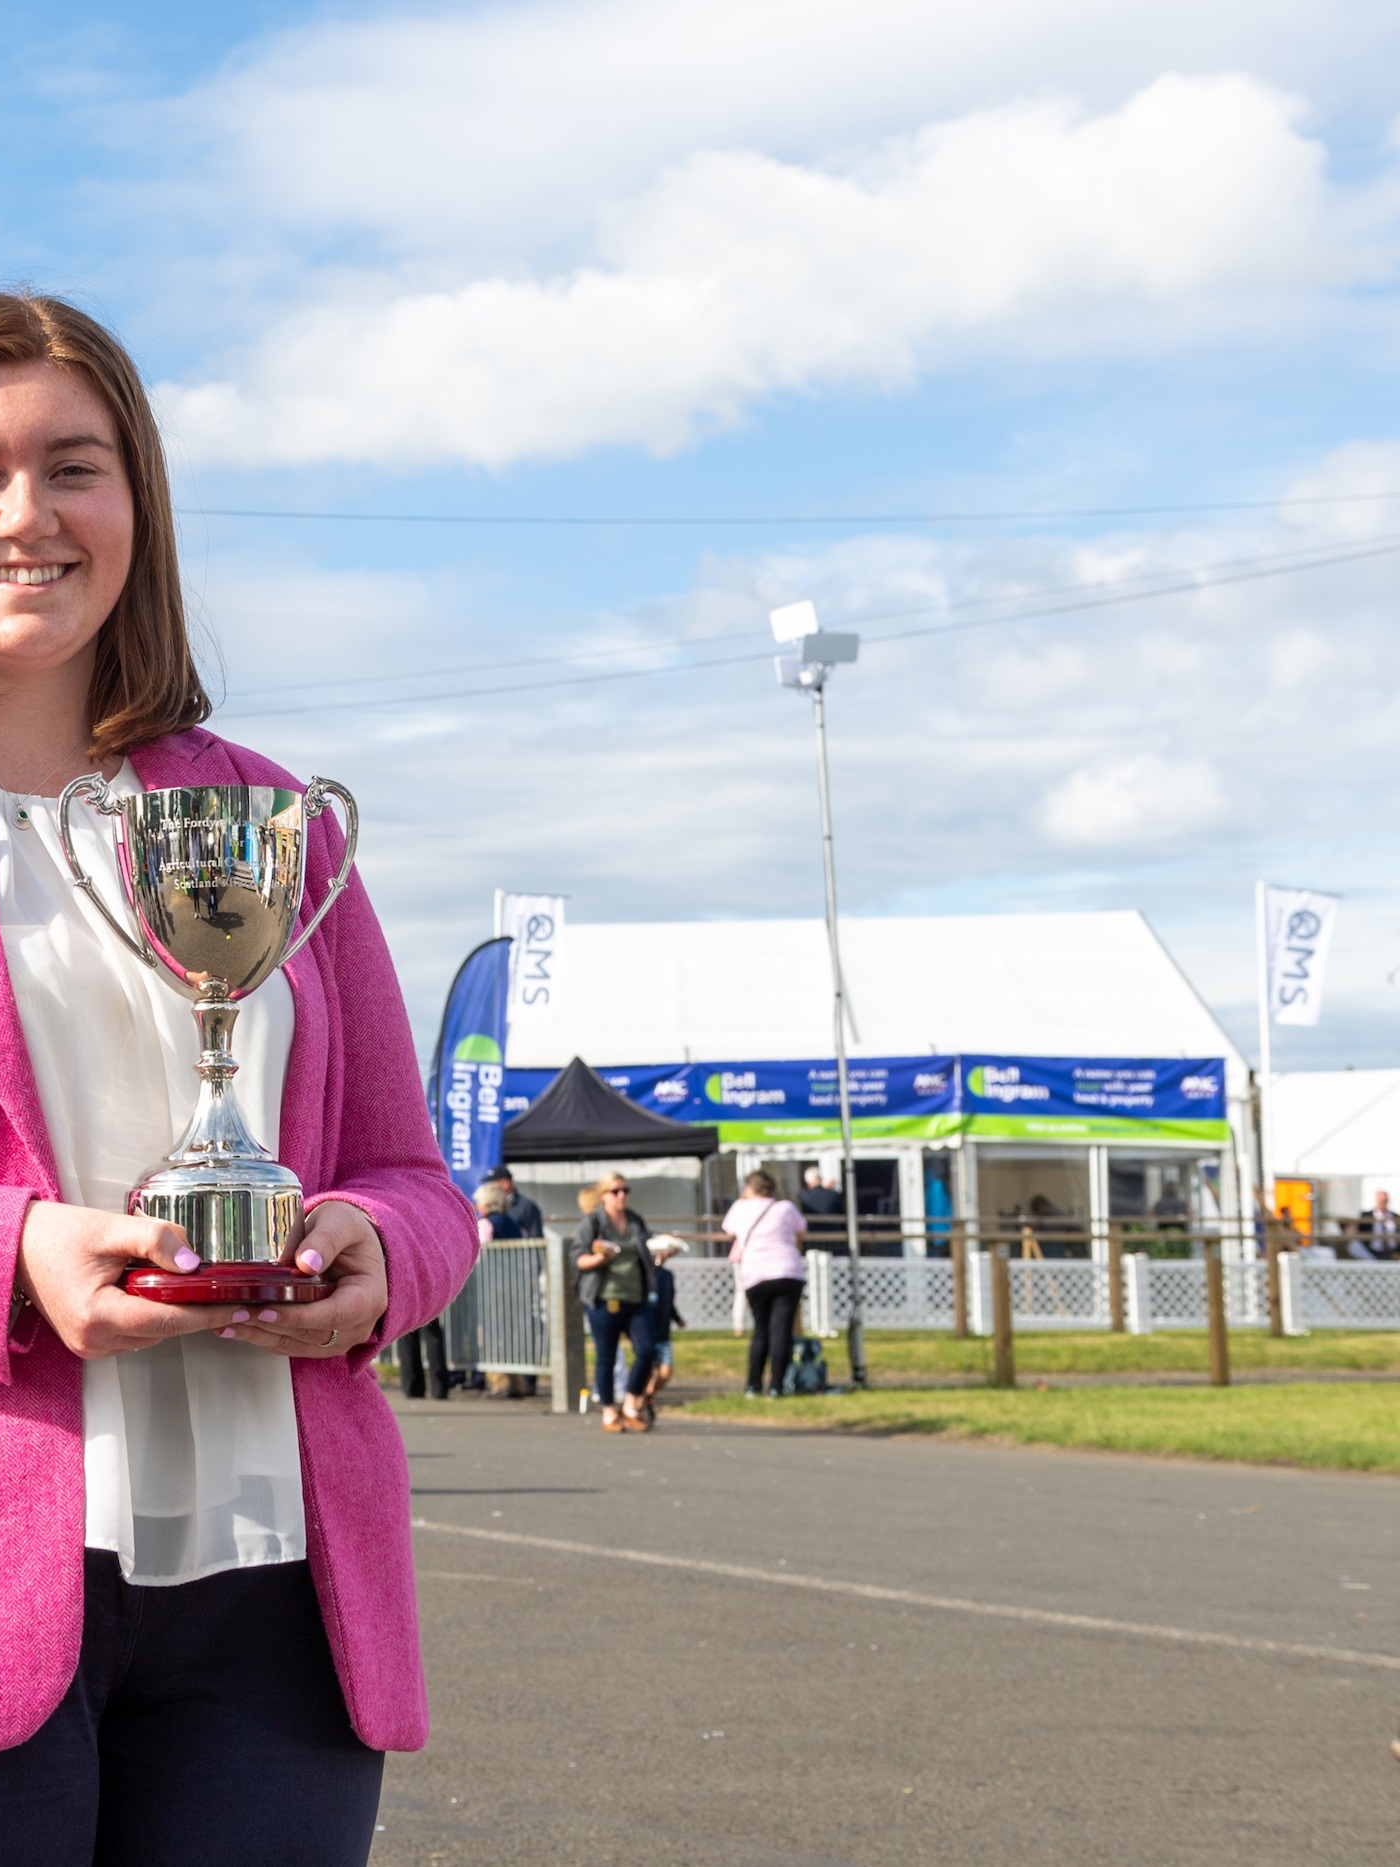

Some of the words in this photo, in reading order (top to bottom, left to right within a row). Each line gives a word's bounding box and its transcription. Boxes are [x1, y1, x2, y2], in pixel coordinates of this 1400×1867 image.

[160, 817, 181, 831] The
[159, 857, 221, 873] Agricultural
[174, 876, 228, 890] Scotlands
[522, 912, 555, 1005] QMS
[1279, 910, 1322, 1005] QMS
[721, 1072, 756, 1089] Bell
[984, 1065, 1020, 1083] Bell
[478, 1063, 503, 1124] Bell
[721, 1089, 786, 1108] Ingram
[984, 1083, 1050, 1103] Ingram
[446, 1062, 477, 1171] Ingram
